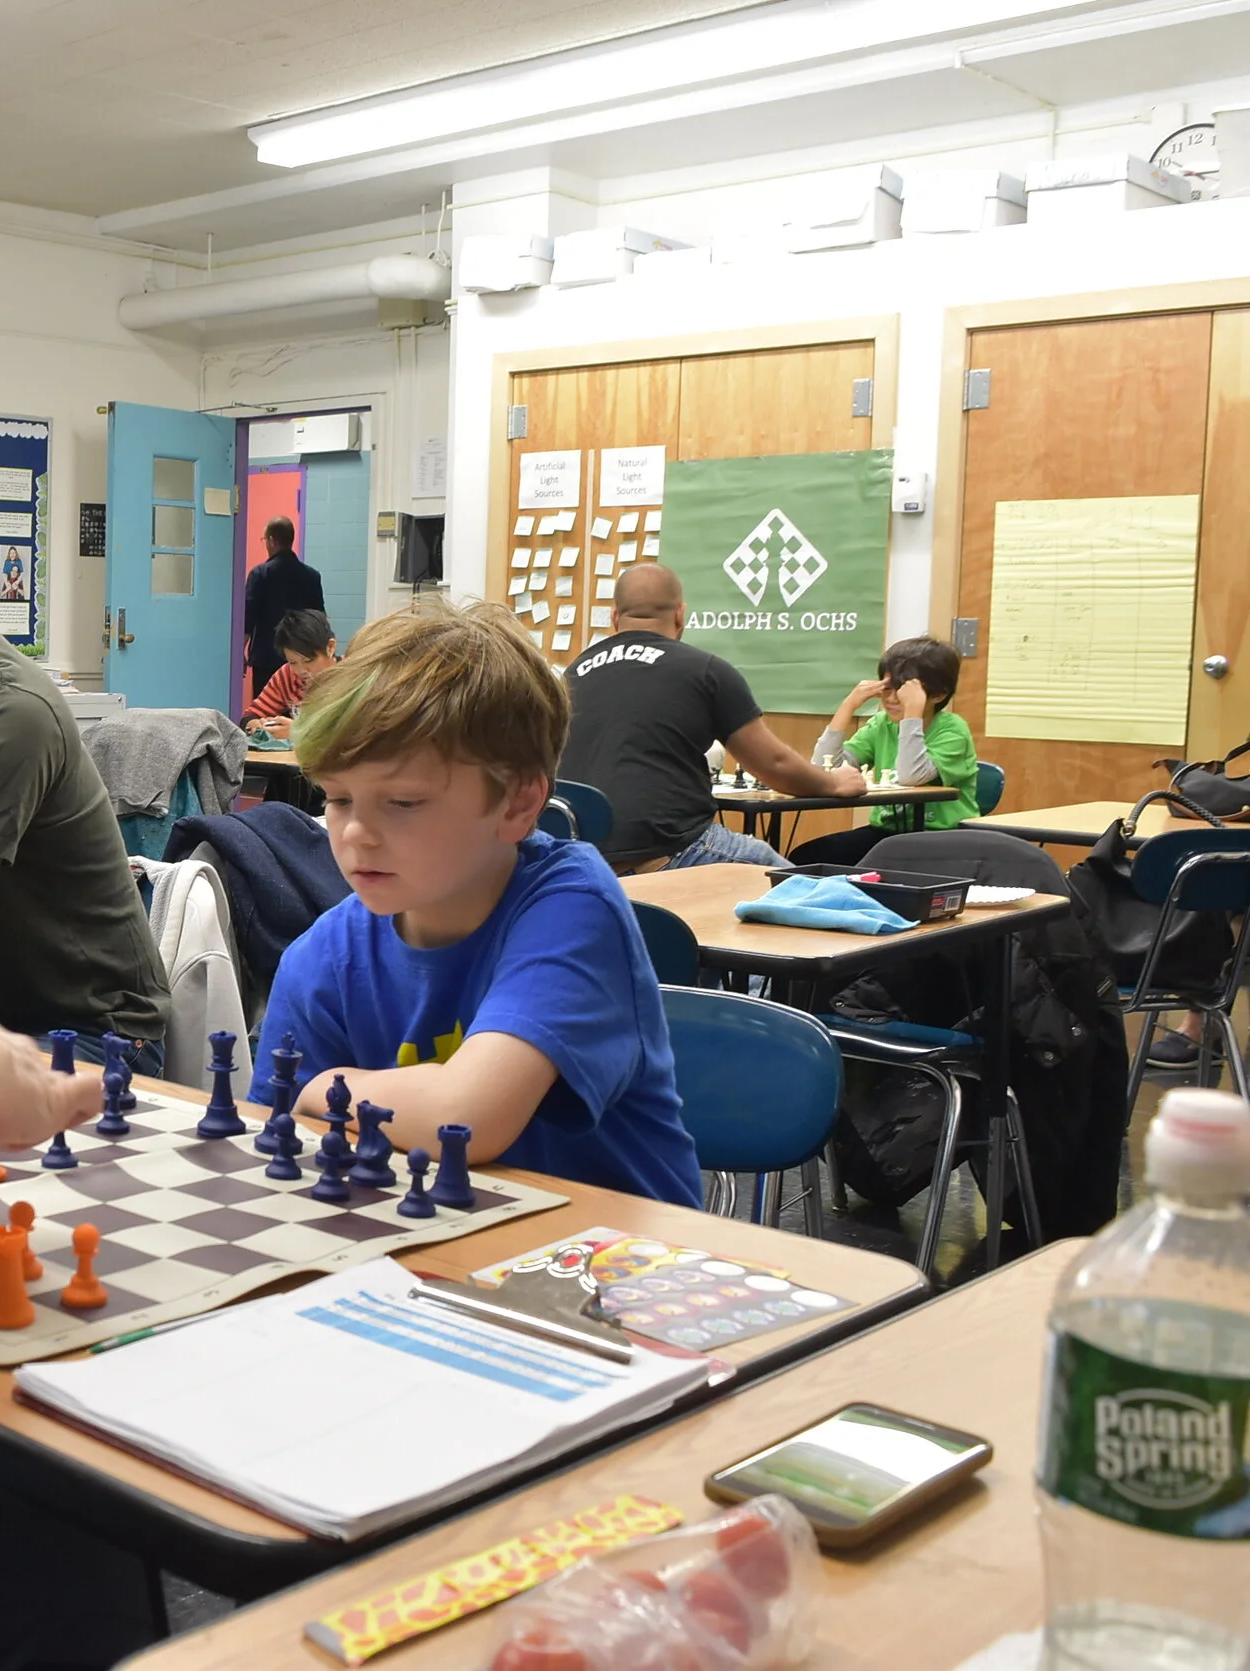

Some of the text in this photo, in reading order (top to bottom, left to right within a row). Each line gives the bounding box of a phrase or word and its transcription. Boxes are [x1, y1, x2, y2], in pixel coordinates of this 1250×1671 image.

[1188, 133, 1203, 146] 12
[1171, 142, 1183, 154] 11
[1158, 157, 1171, 168] 10
[534, 461, 566, 471] Artificial
[618, 458, 648, 468] Natural
[540, 476, 559, 486] Light
[622, 472, 642, 482] Light
[534, 489, 564, 498] Sources
[616, 486, 647, 495] Sources
[684, 612, 858, 631] ADOLPH S. OCHS
[576, 644, 666, 677] COACH
[1095, 1397, 1231, 1440] Poland
[1096, 1435, 1232, 1480] Spring
